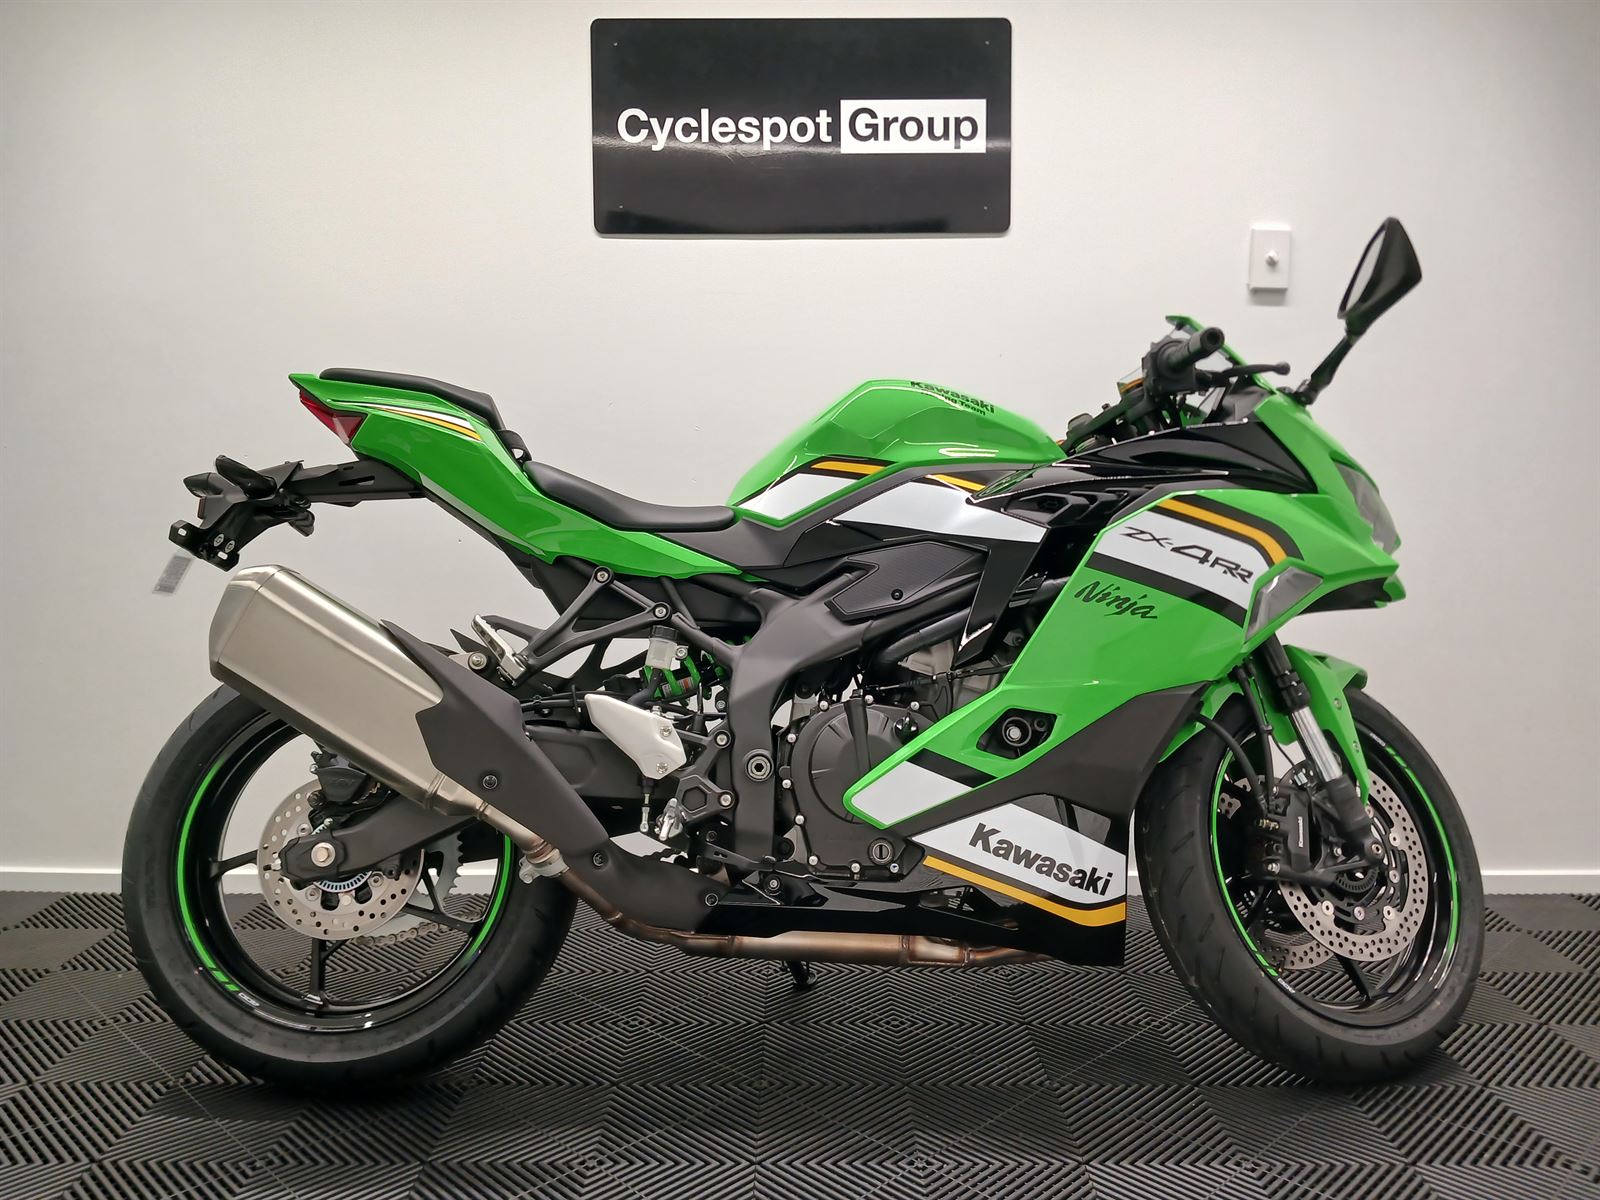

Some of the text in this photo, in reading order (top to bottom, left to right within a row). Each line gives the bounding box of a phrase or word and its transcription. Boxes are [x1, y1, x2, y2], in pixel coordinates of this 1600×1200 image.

[616, 107, 979, 151] Cyclespot Group
[910, 380, 995, 414] Kawasaki
[959, 399, 986, 416] Team
[1119, 526, 1255, 584] ZX-4RR
[1074, 580, 1158, 620] Ninja
[968, 822, 1114, 896] Kawasaki
